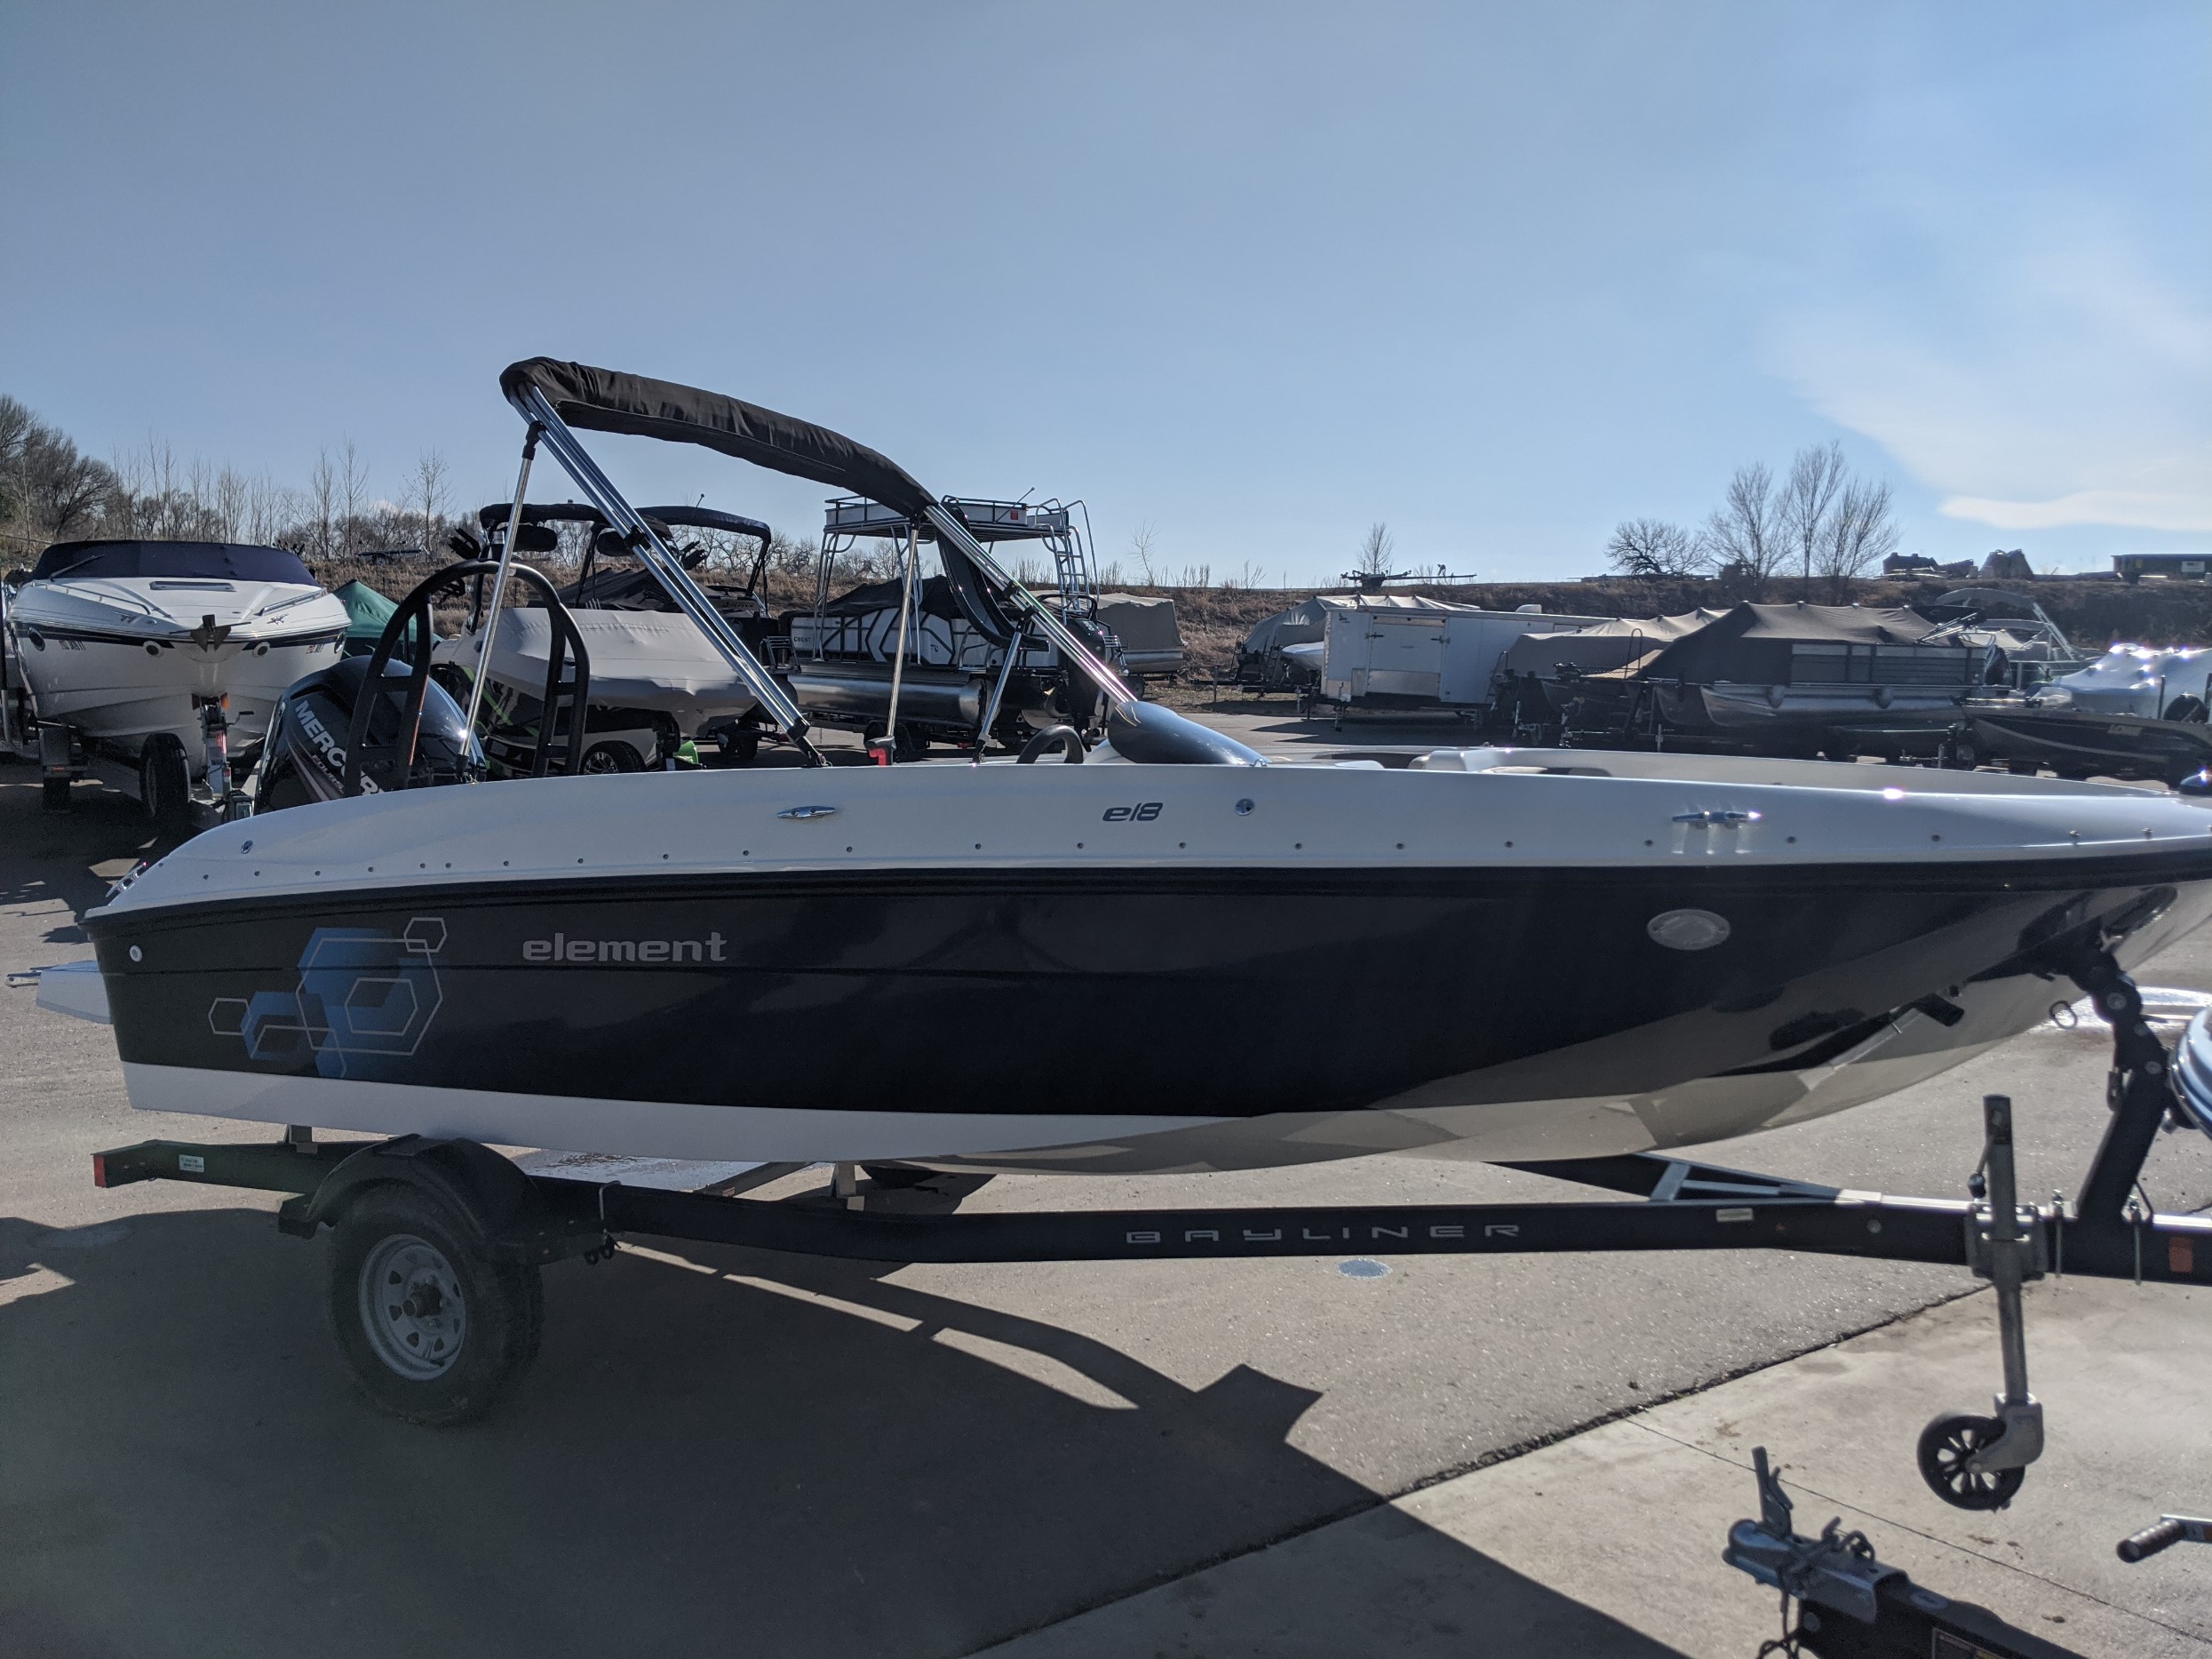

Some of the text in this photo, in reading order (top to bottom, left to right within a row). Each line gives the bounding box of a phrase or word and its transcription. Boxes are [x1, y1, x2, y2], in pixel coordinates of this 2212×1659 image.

[295, 699, 386, 795] MERCR
[522, 931, 728, 961] element
[1126, 1224, 1519, 1243] BAYLINER
